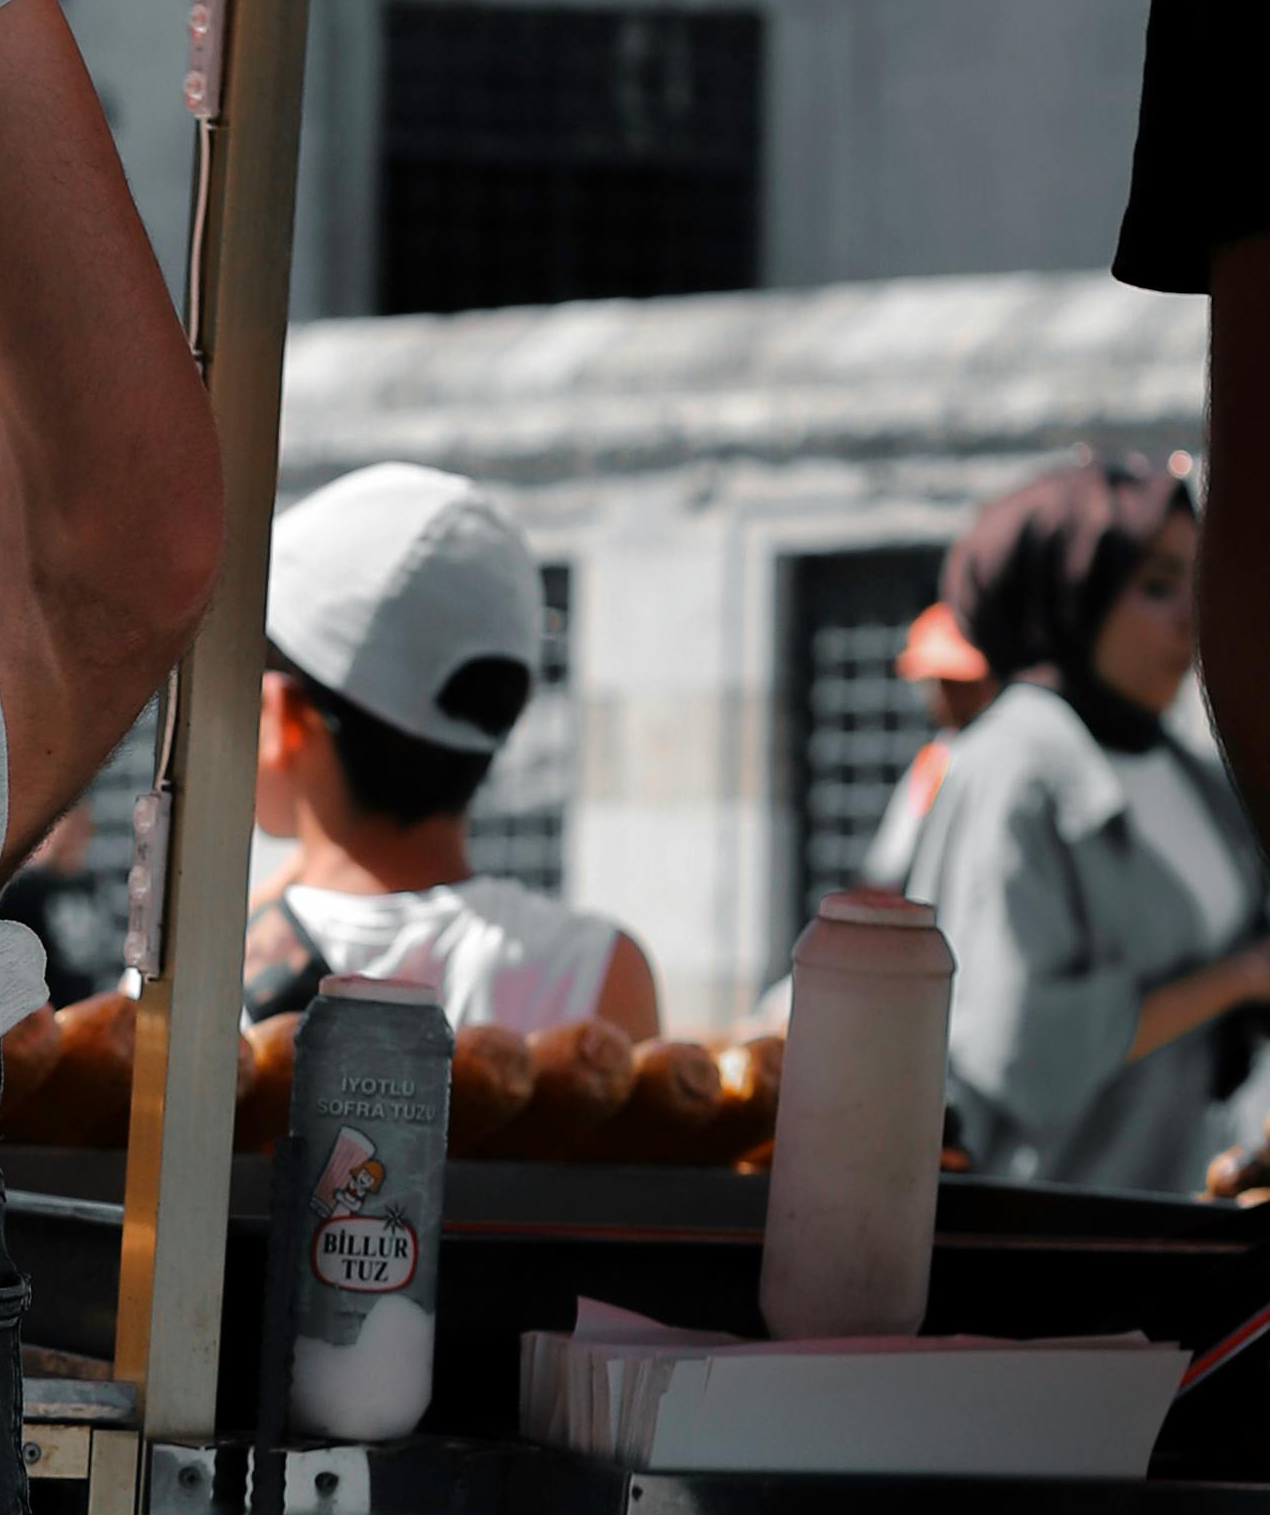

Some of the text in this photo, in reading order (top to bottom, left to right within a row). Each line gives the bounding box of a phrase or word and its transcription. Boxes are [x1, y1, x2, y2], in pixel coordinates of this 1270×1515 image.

[317, 1098, 384, 1118] SOFRA
[323, 1228, 408, 1258] BİLLUR
[342, 1258, 389, 1282] TUZ
